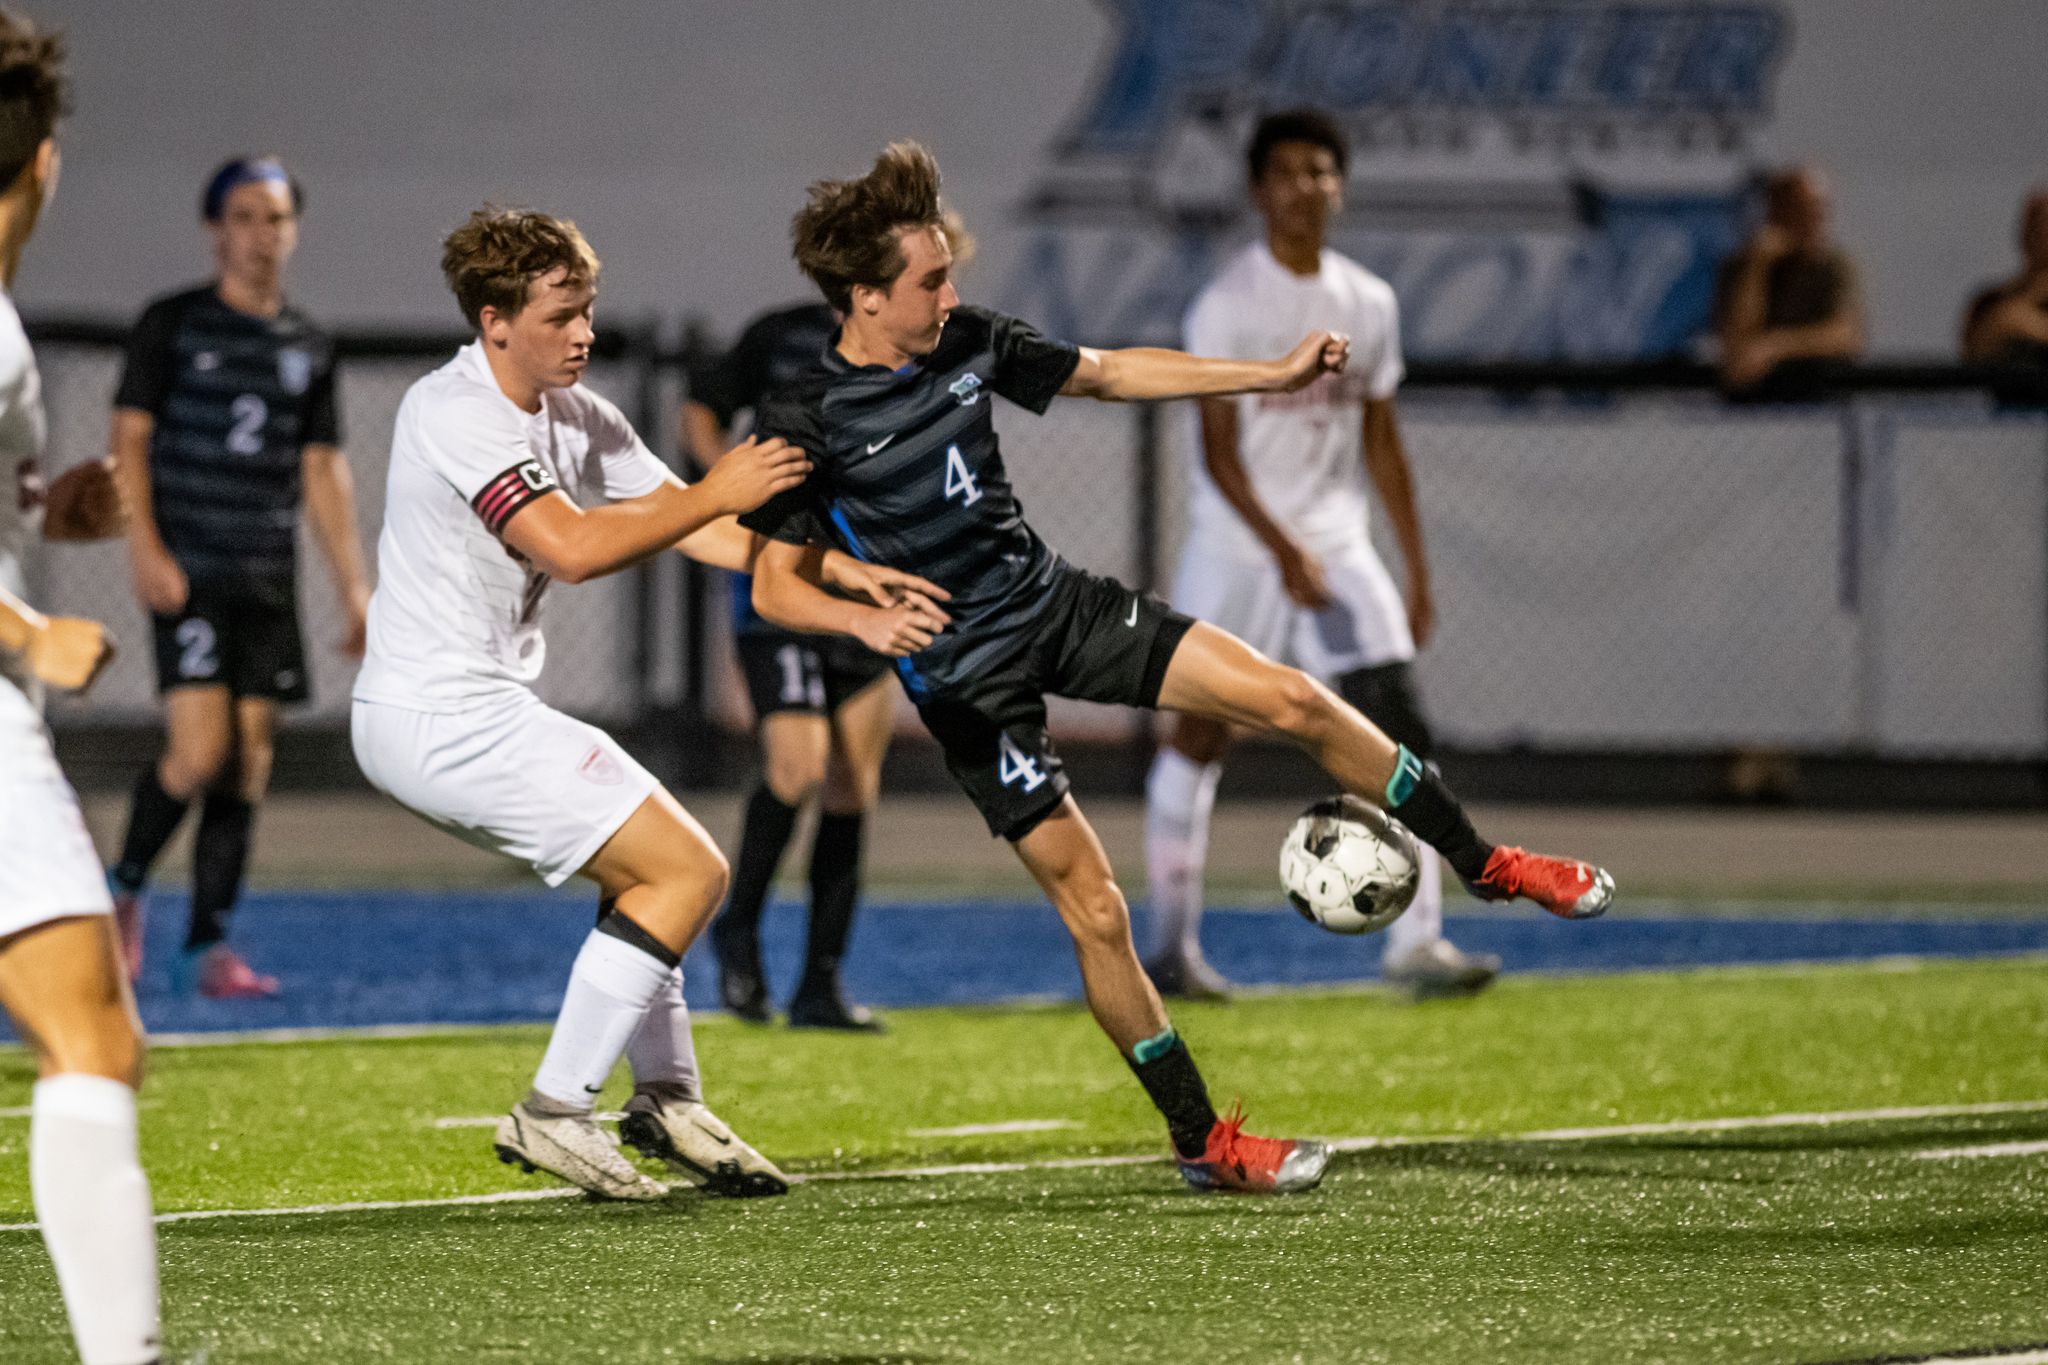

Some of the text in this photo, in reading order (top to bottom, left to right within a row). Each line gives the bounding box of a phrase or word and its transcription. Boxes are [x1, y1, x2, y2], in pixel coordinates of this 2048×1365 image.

[226, 393, 269, 456] 2
[944, 445, 984, 508] 4
[174, 616, 221, 679] 2
[999, 731, 1048, 793] 4
